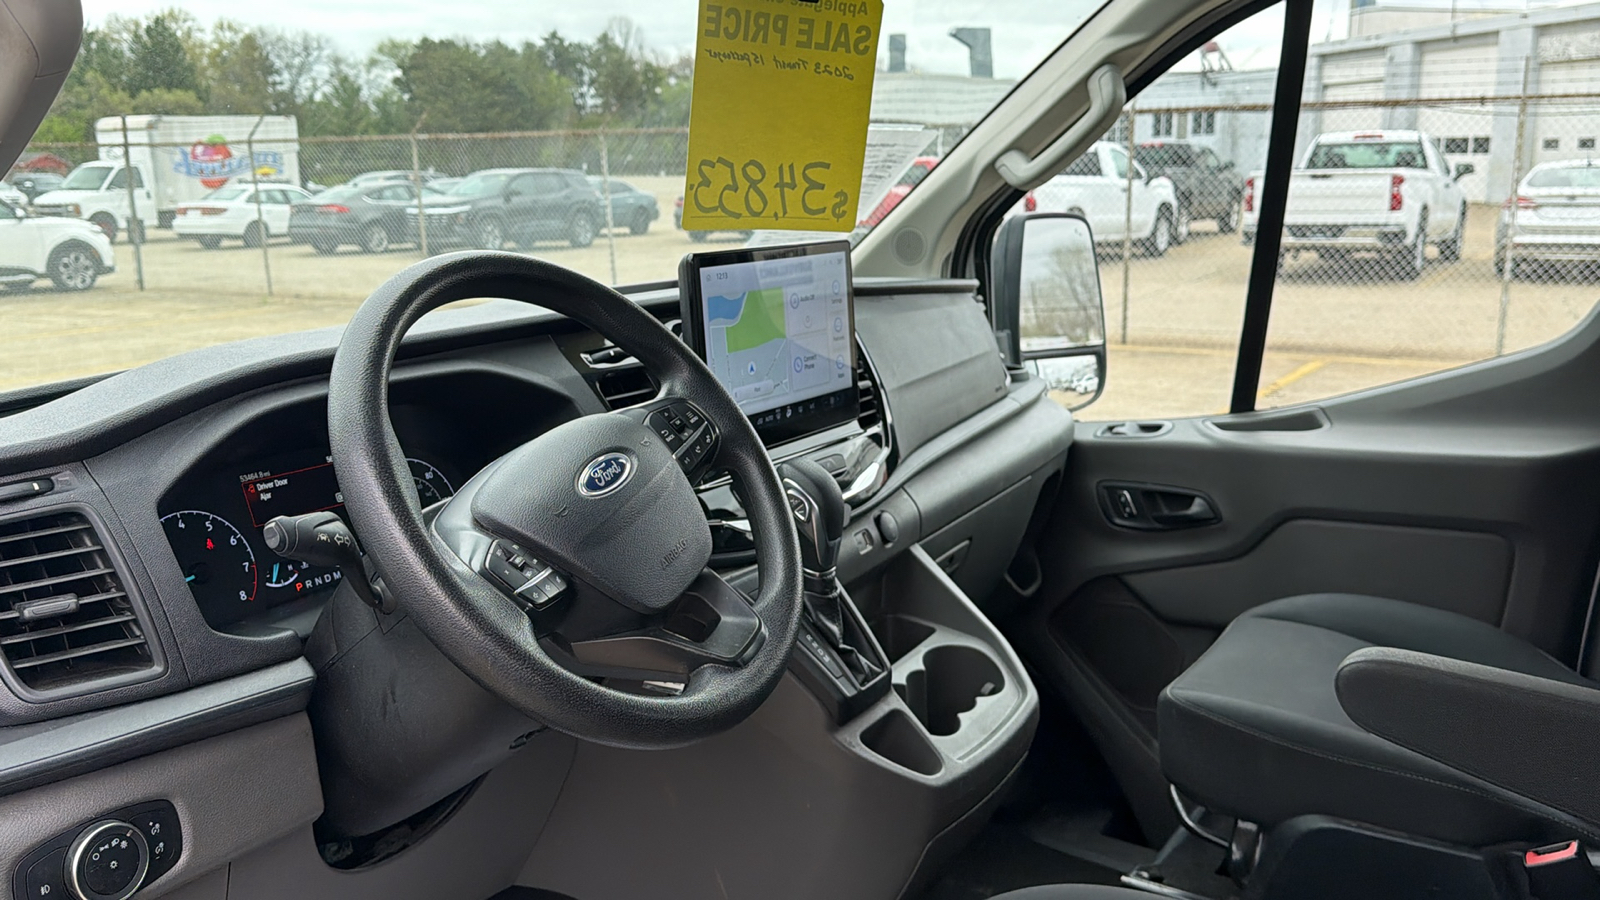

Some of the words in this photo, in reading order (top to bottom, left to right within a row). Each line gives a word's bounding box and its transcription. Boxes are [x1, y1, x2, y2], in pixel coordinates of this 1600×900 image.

[590, 460, 622, 487] Ford
[256, 481, 274, 492] Driver
[274, 478, 288, 489] Door
[260, 492, 272, 501] Ajar
[178, 519, 185, 529] 4
[206, 521, 213, 532] 5
[230, 536, 237, 546] 6
[661, 538, 688, 570] AIRBAG
[242, 562, 250, 573] 7
[295, 582, 303, 592] P
[305, 580, 313, 589] R
[314, 577, 323, 586] N
[324, 574, 332, 583] D
[333, 571, 342, 580] M
[239, 590, 248, 601] 8
